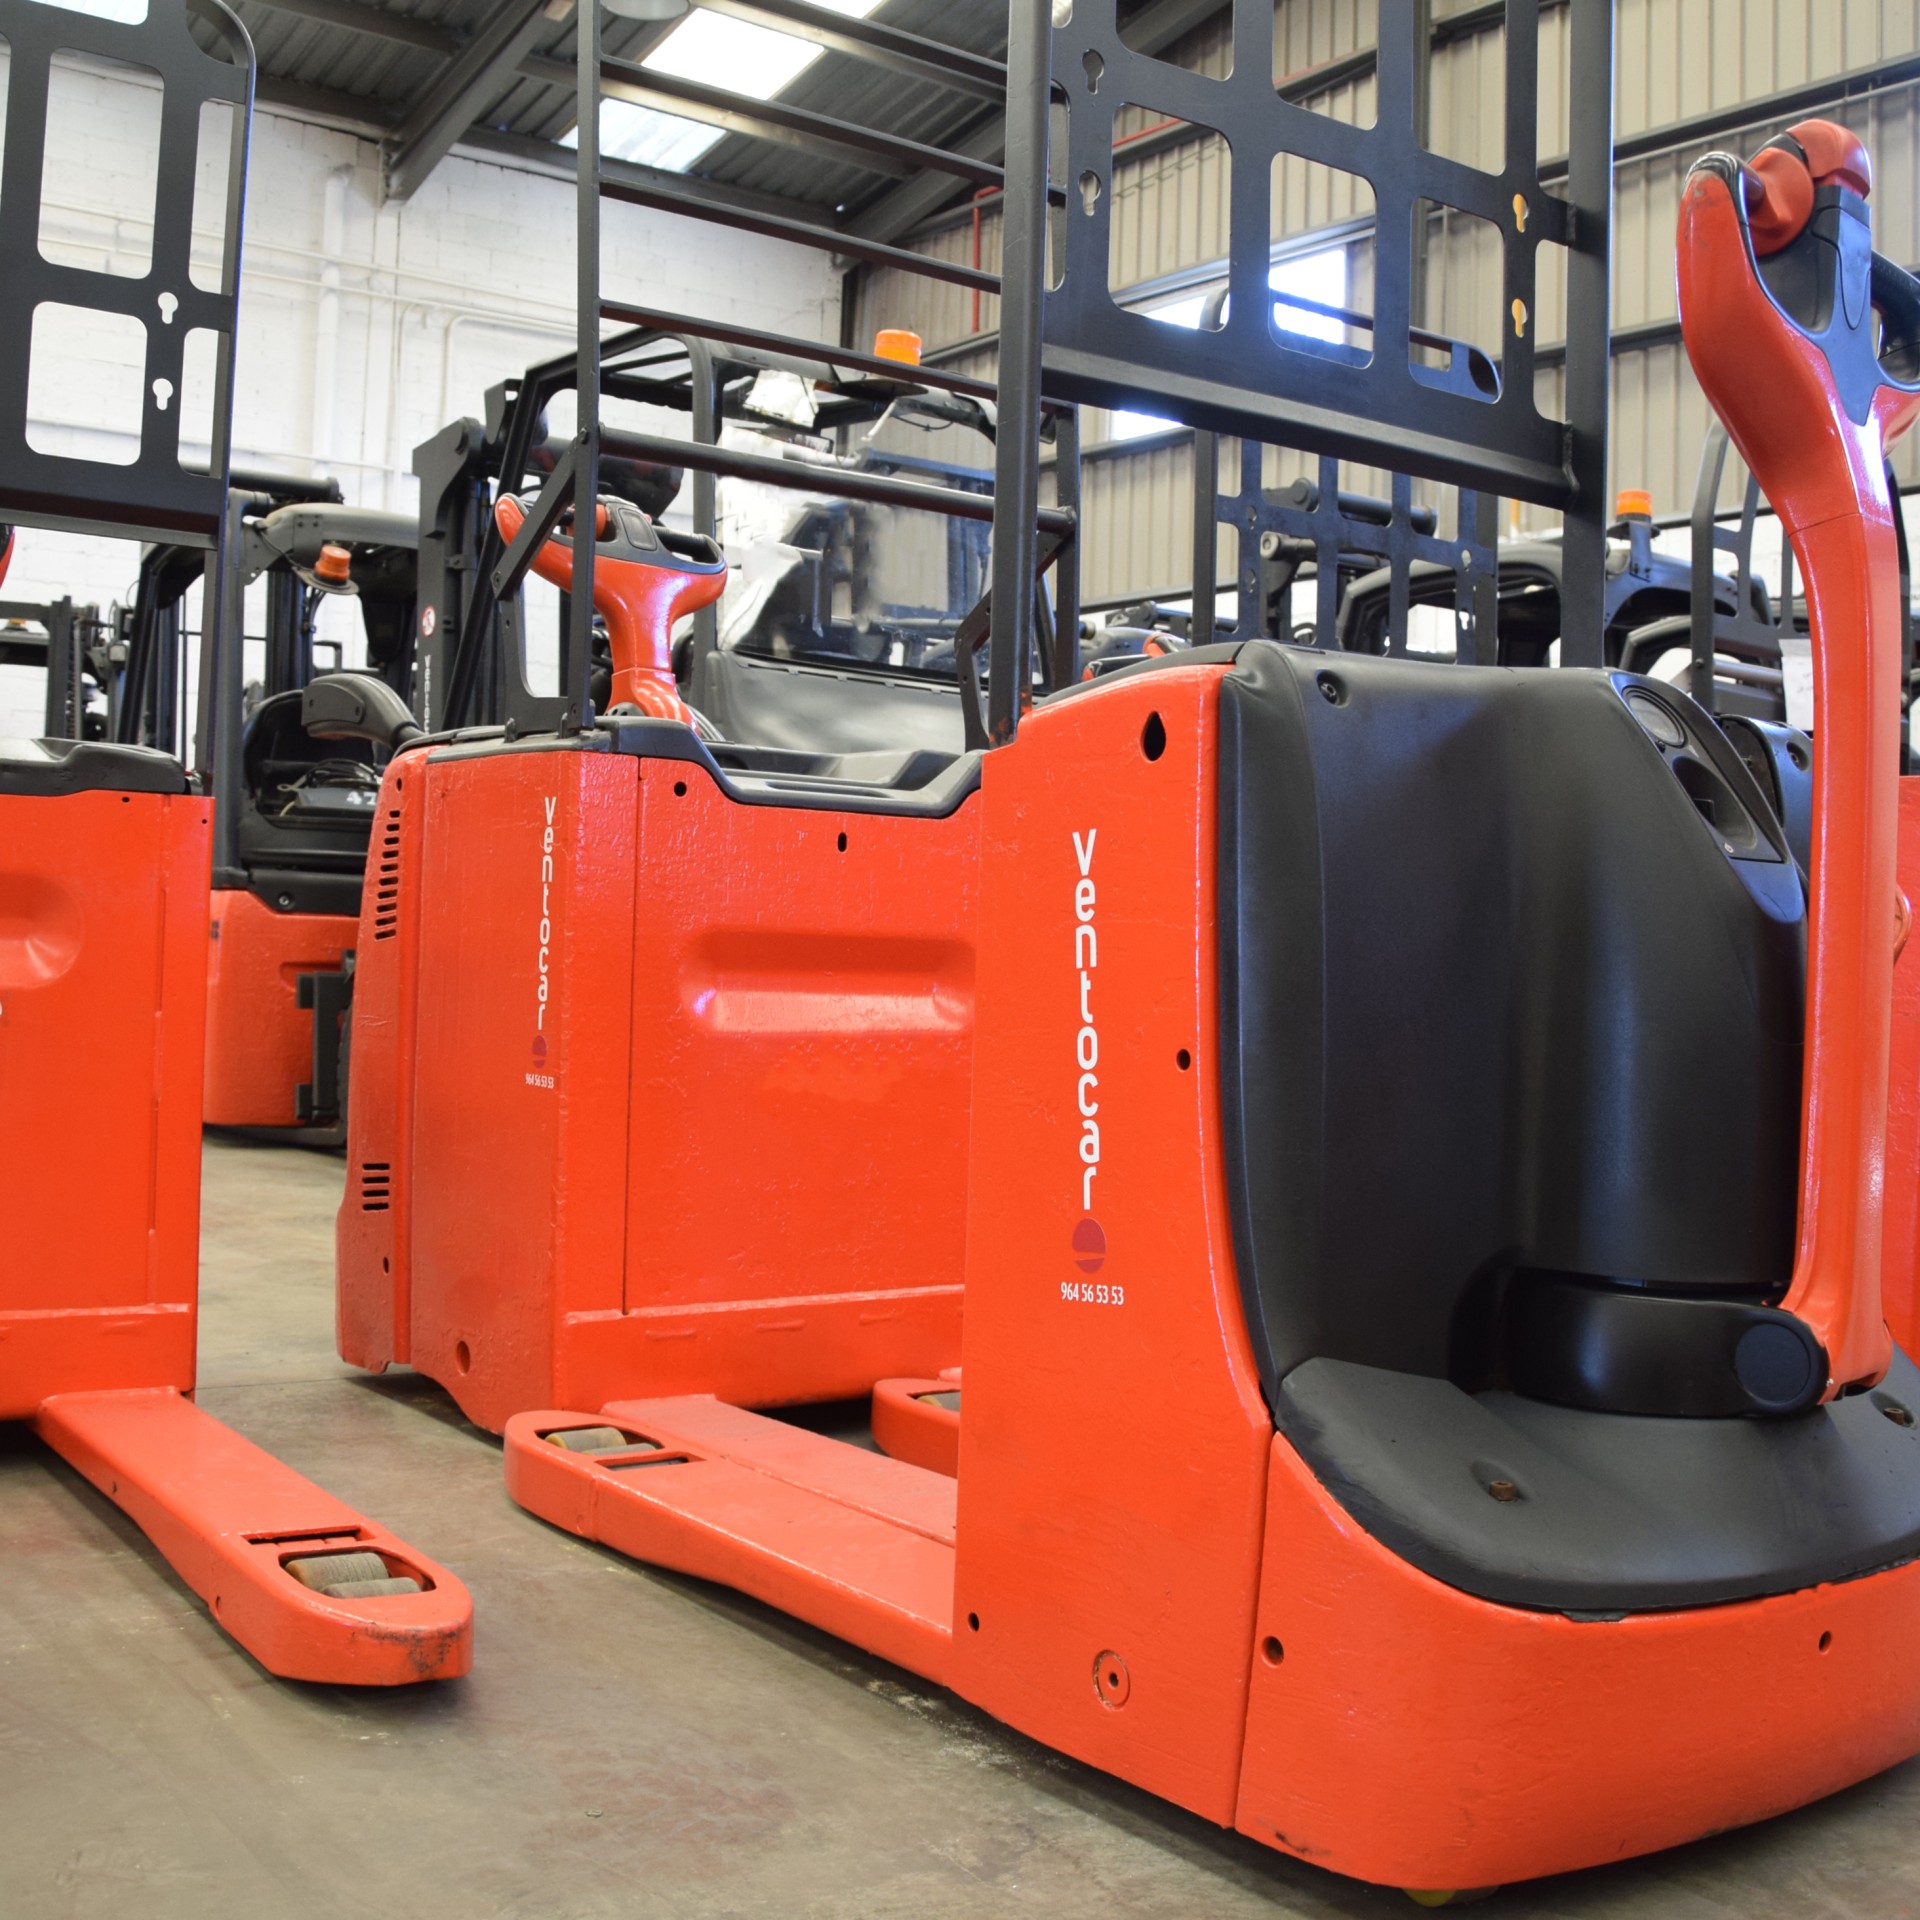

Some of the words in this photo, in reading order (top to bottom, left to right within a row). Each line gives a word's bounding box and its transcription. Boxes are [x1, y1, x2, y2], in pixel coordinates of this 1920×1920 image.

[537, 796, 556, 1030] ventocar
[1072, 828, 1101, 1210] ventocar
[1060, 1281, 1079, 1301] 964
[1081, 1283, 1094, 1303] 56
[1096, 1284, 1109, 1304] 53
[1111, 1285, 1124, 1305] 53
